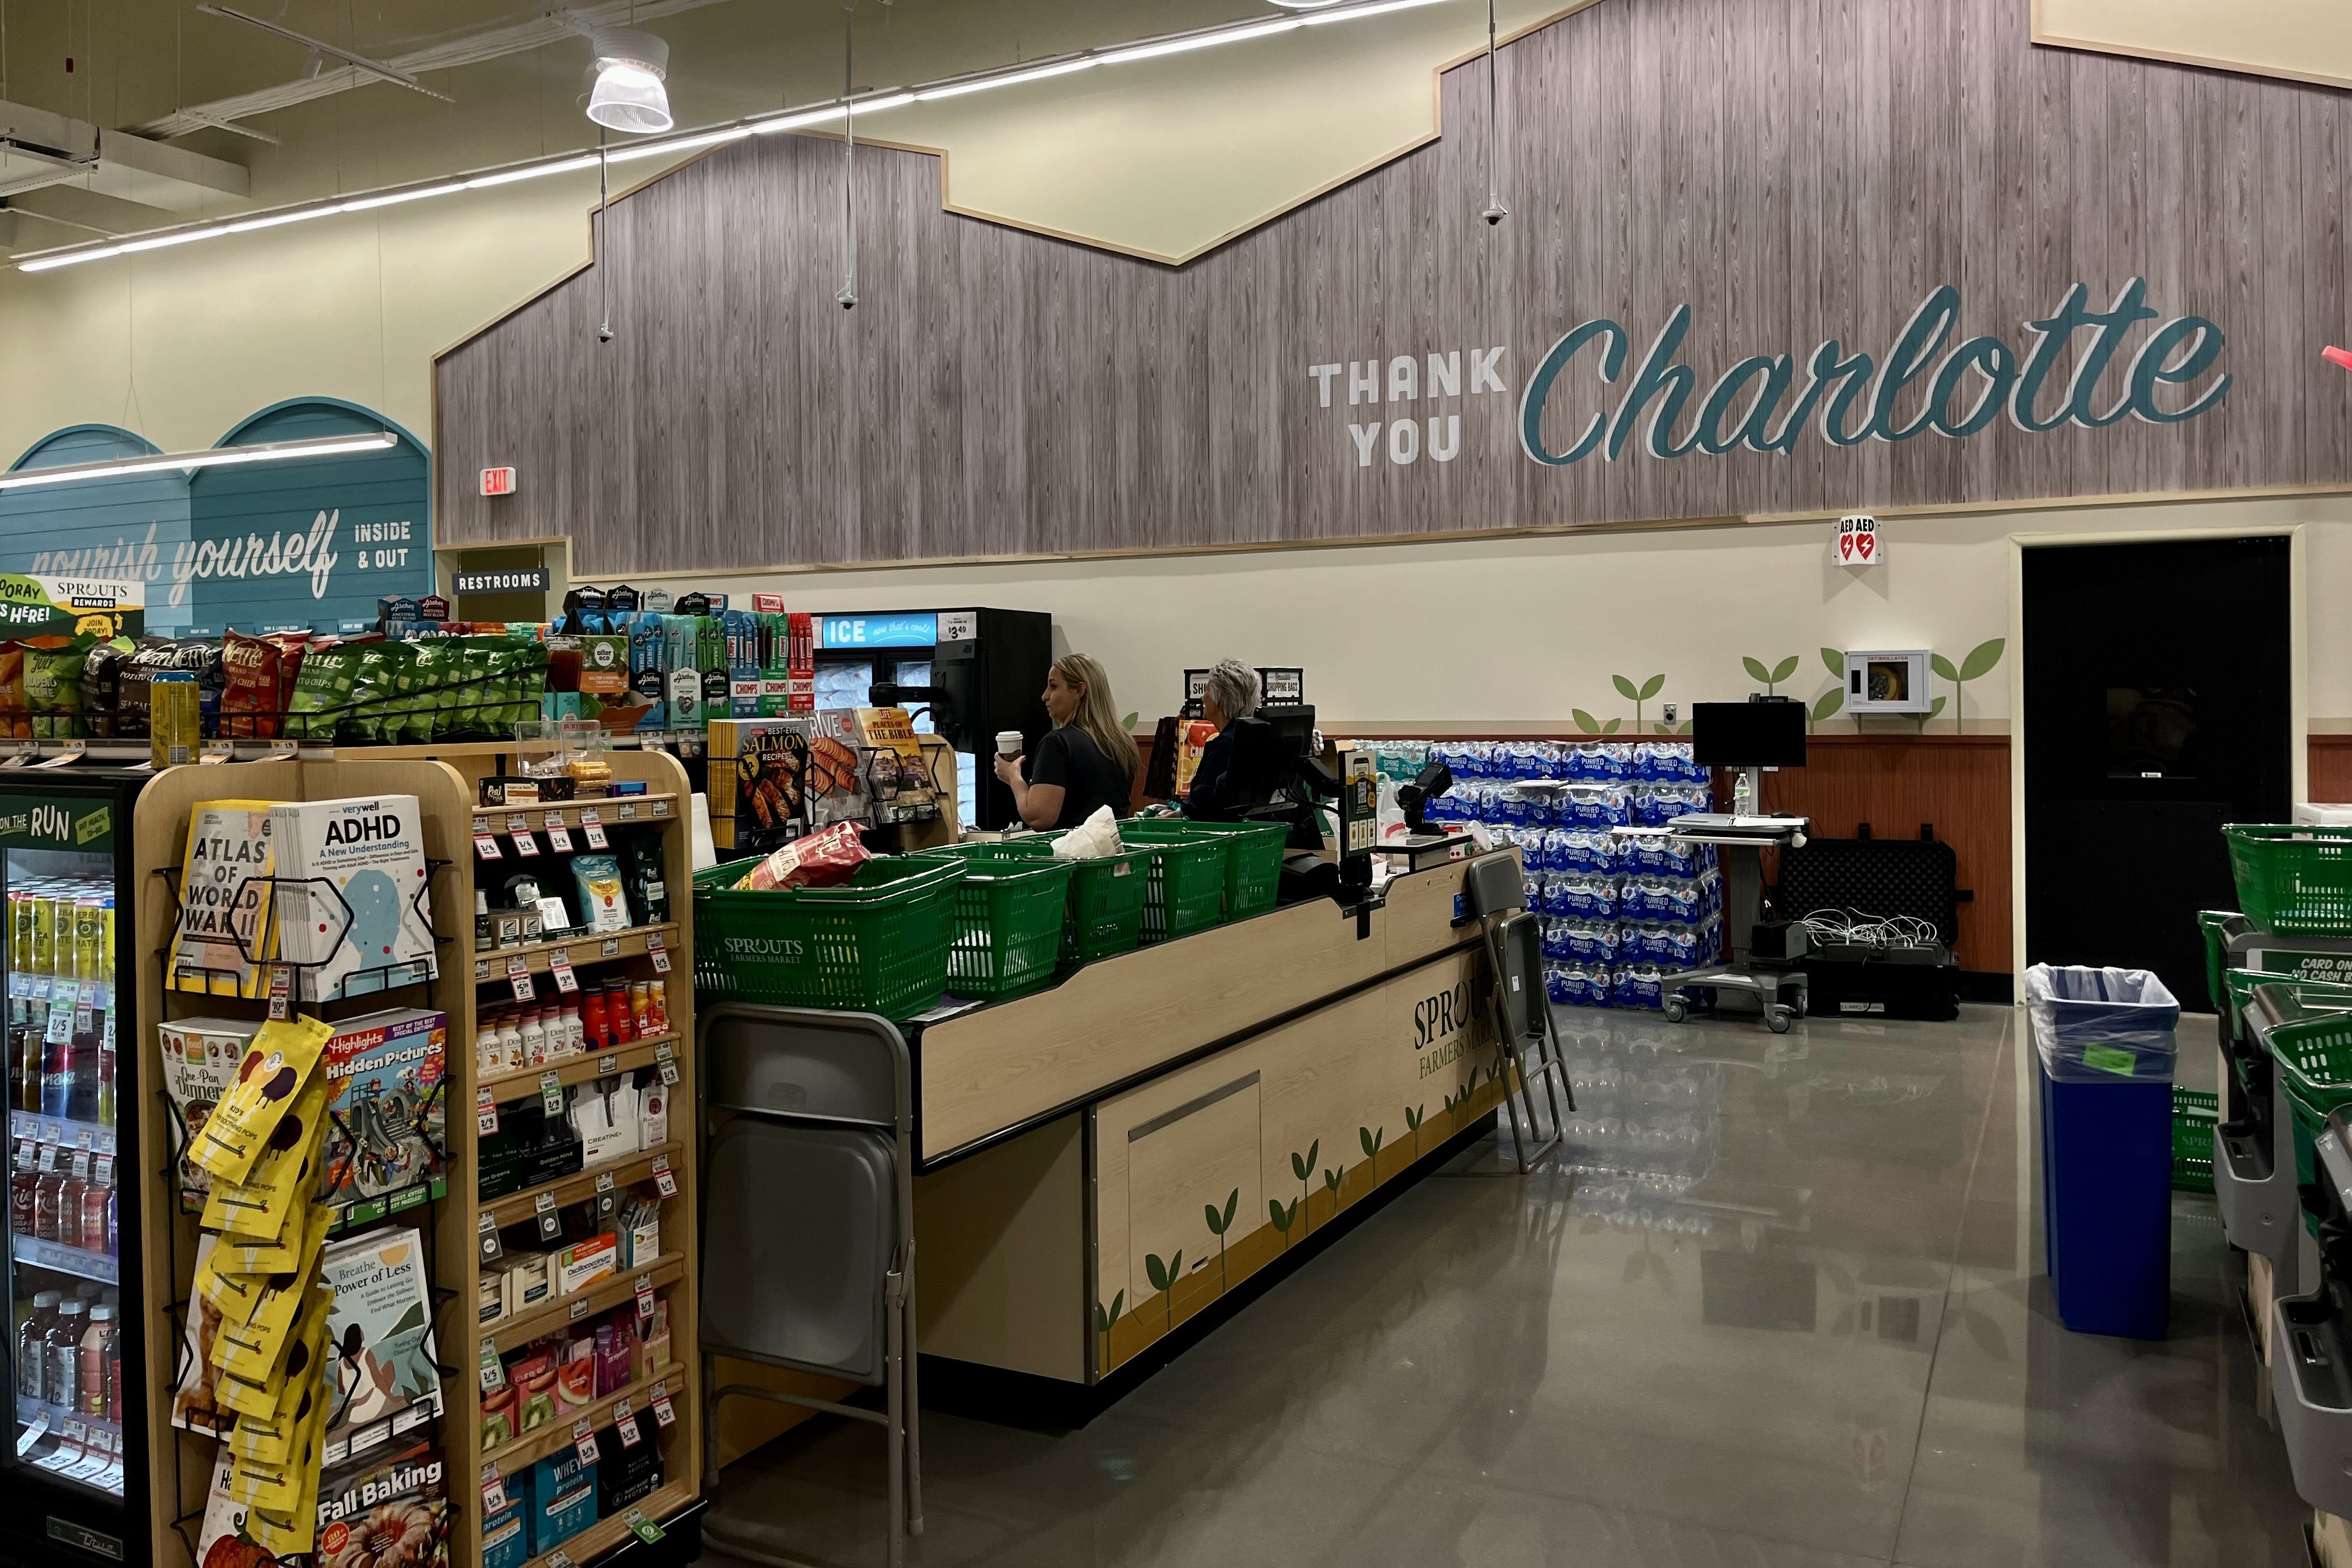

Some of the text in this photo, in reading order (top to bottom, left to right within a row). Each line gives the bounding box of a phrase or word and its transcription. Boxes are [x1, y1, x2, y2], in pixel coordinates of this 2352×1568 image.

[1309, 346, 1507, 407] THANK
[1518, 276, 2233, 466] Charlotte
[1348, 415, 1459, 466] YOU
[485, 469, 508, 494] EXIT
[355, 521, 411, 542] INSIDE
[1840, 519, 1874, 533] AED AED
[32, 509, 340, 609] nourish yourself
[359, 548, 408, 569] & OUT
[459, 573, 540, 590] RESTROOMS
[0, 579, 40, 600] OORAY
[58, 582, 128, 597] SPROUTS
[74, 598, 114, 607] REWARDS
[391, 603, 414, 611] Archer
[422, 599, 443, 608] Archer
[762, 597, 779, 607] CHOMPS
[9, 606, 50, 623] HERE!
[830, 621, 866, 642] ICE
[874, 626, 887, 635] now
[889, 621, 909, 631] that's
[31, 657, 56, 673] JULY
[237, 678, 256, 688] CHIPS
[638, 673, 660, 685] Archer
[674, 673, 695, 684] Archer
[705, 673, 725, 684] Archer
[736, 684, 758, 694] CHOMPS
[765, 682, 786, 692] CHOMPS
[793, 681, 812, 692] CHOMPS
[878, 709, 891, 719] LIFE
[768, 726, 800, 736] BEST-EVER
[867, 729, 914, 740] THE BIBLE
[743, 735, 804, 752] SALMON
[762, 752, 788, 761] RECIPES
[488, 785, 502, 798] Real
[342, 802, 379, 814] verywell
[12, 814, 27, 827] THE
[31, 805, 69, 841] RUN
[325, 815, 401, 846] ADHD
[194, 838, 265, 863] ATLAS
[328, 848, 346, 857] New
[349, 841, 410, 854] Understanding
[1565, 848, 1590, 858] PURIFIED
[1639, 852, 1663, 861] PURIFIED
[215, 866, 238, 883] OF
[189, 886, 258, 909] WORLD
[1567, 895, 1591, 904] PURIFIED
[1644, 896, 1668, 905] PURIFIED
[186, 909, 256, 936] WAR II
[724, 938, 803, 954] SPROUTS
[1570, 940, 1594, 949] PURIFIED
[1642, 939, 1667, 948] PURIFIED
[731, 954, 801, 964] FARMERS MARKET
[2301, 958, 2352, 970] CARD ON
[2311, 970, 2342, 981] CASH
[1561, 980, 1585, 989] PURIFIED
[1633, 982, 1658, 992] PURIFIED
[1415, 974, 1482, 1050] SPROU
[52, 1019, 66, 1031] 2/5
[187, 1037, 202, 1049] food
[329, 1033, 383, 1055] Highlights
[527, 1034, 545, 1042] Dose
[327, 1042, 442, 1080] Hidden Pictures
[1419, 1035, 1464, 1080] FARMERS
[181, 1066, 219, 1085] One-Pan
[242, 1129, 258, 1140] POPS
[560, 1151, 573, 1159] Mind
[491, 1170, 510, 1179] Greens
[339, 1261, 376, 1280] Breathe
[334, 1263, 411, 1297] Power of Less
[365, 1288, 379, 1298] Guide
[554, 1458, 582, 1482] WHEY
[556, 1474, 584, 1495] protein
[317, 1489, 358, 1527] Fall
[362, 1461, 442, 1507] Baking
[482, 1510, 512, 1533] protein
